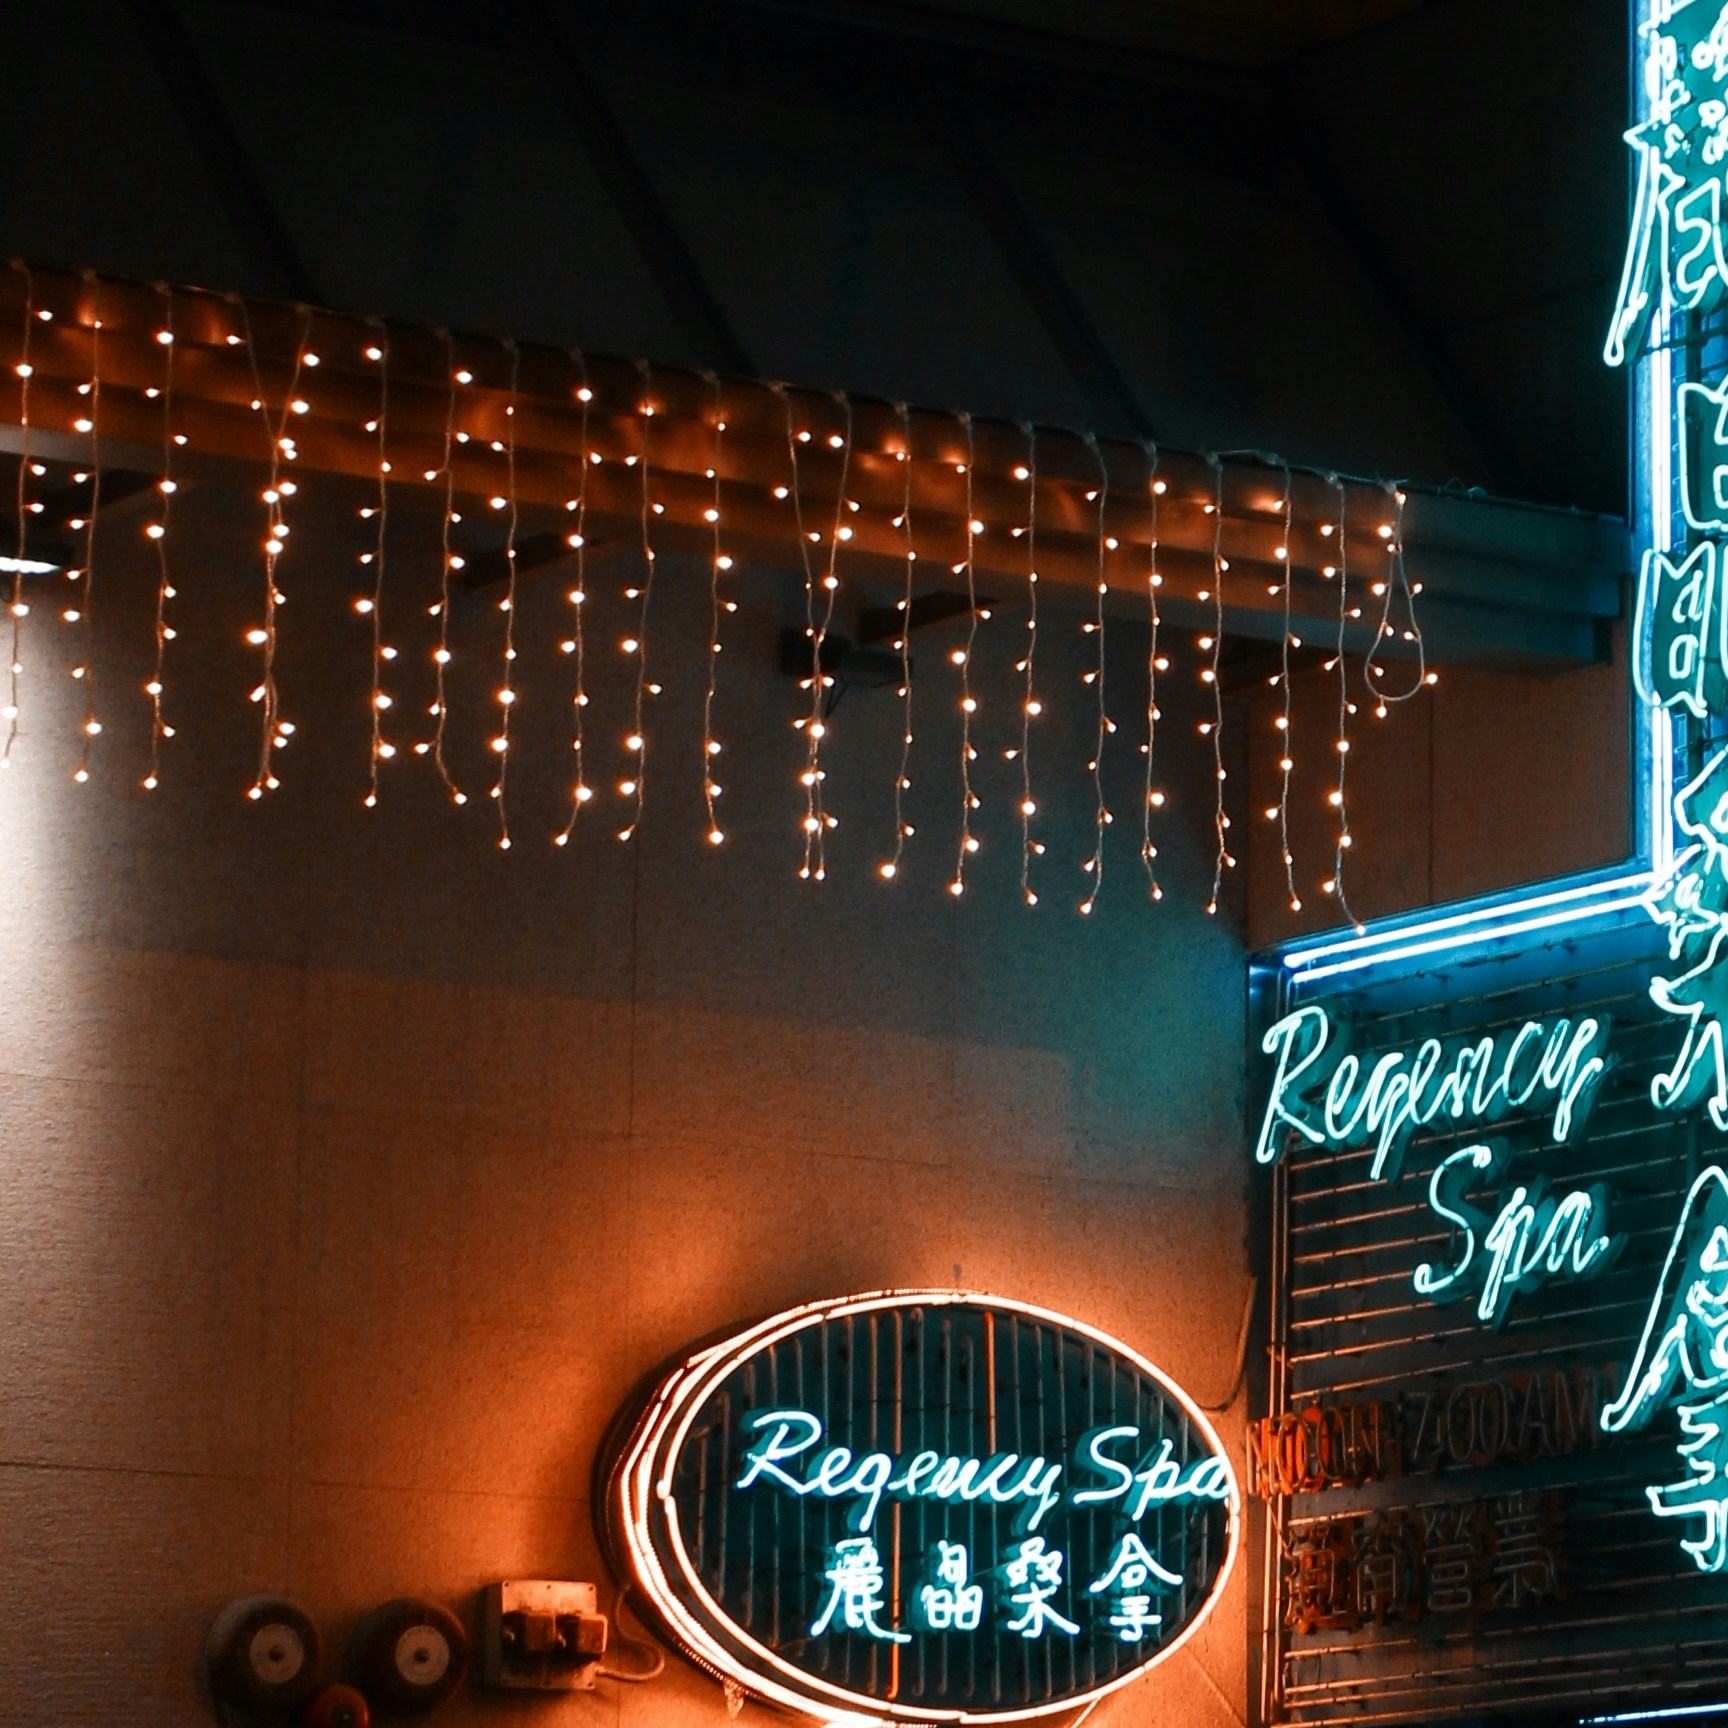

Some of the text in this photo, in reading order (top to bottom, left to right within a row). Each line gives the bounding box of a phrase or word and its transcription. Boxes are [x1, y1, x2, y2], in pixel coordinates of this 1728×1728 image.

[1257, 1005, 1603, 1180] Regency
[1414, 1145, 1611, 1320] Spa
[736, 1409, 1232, 1532] Regency Spa
[811, 1532, 1183, 1644] 麗晶桑拿
